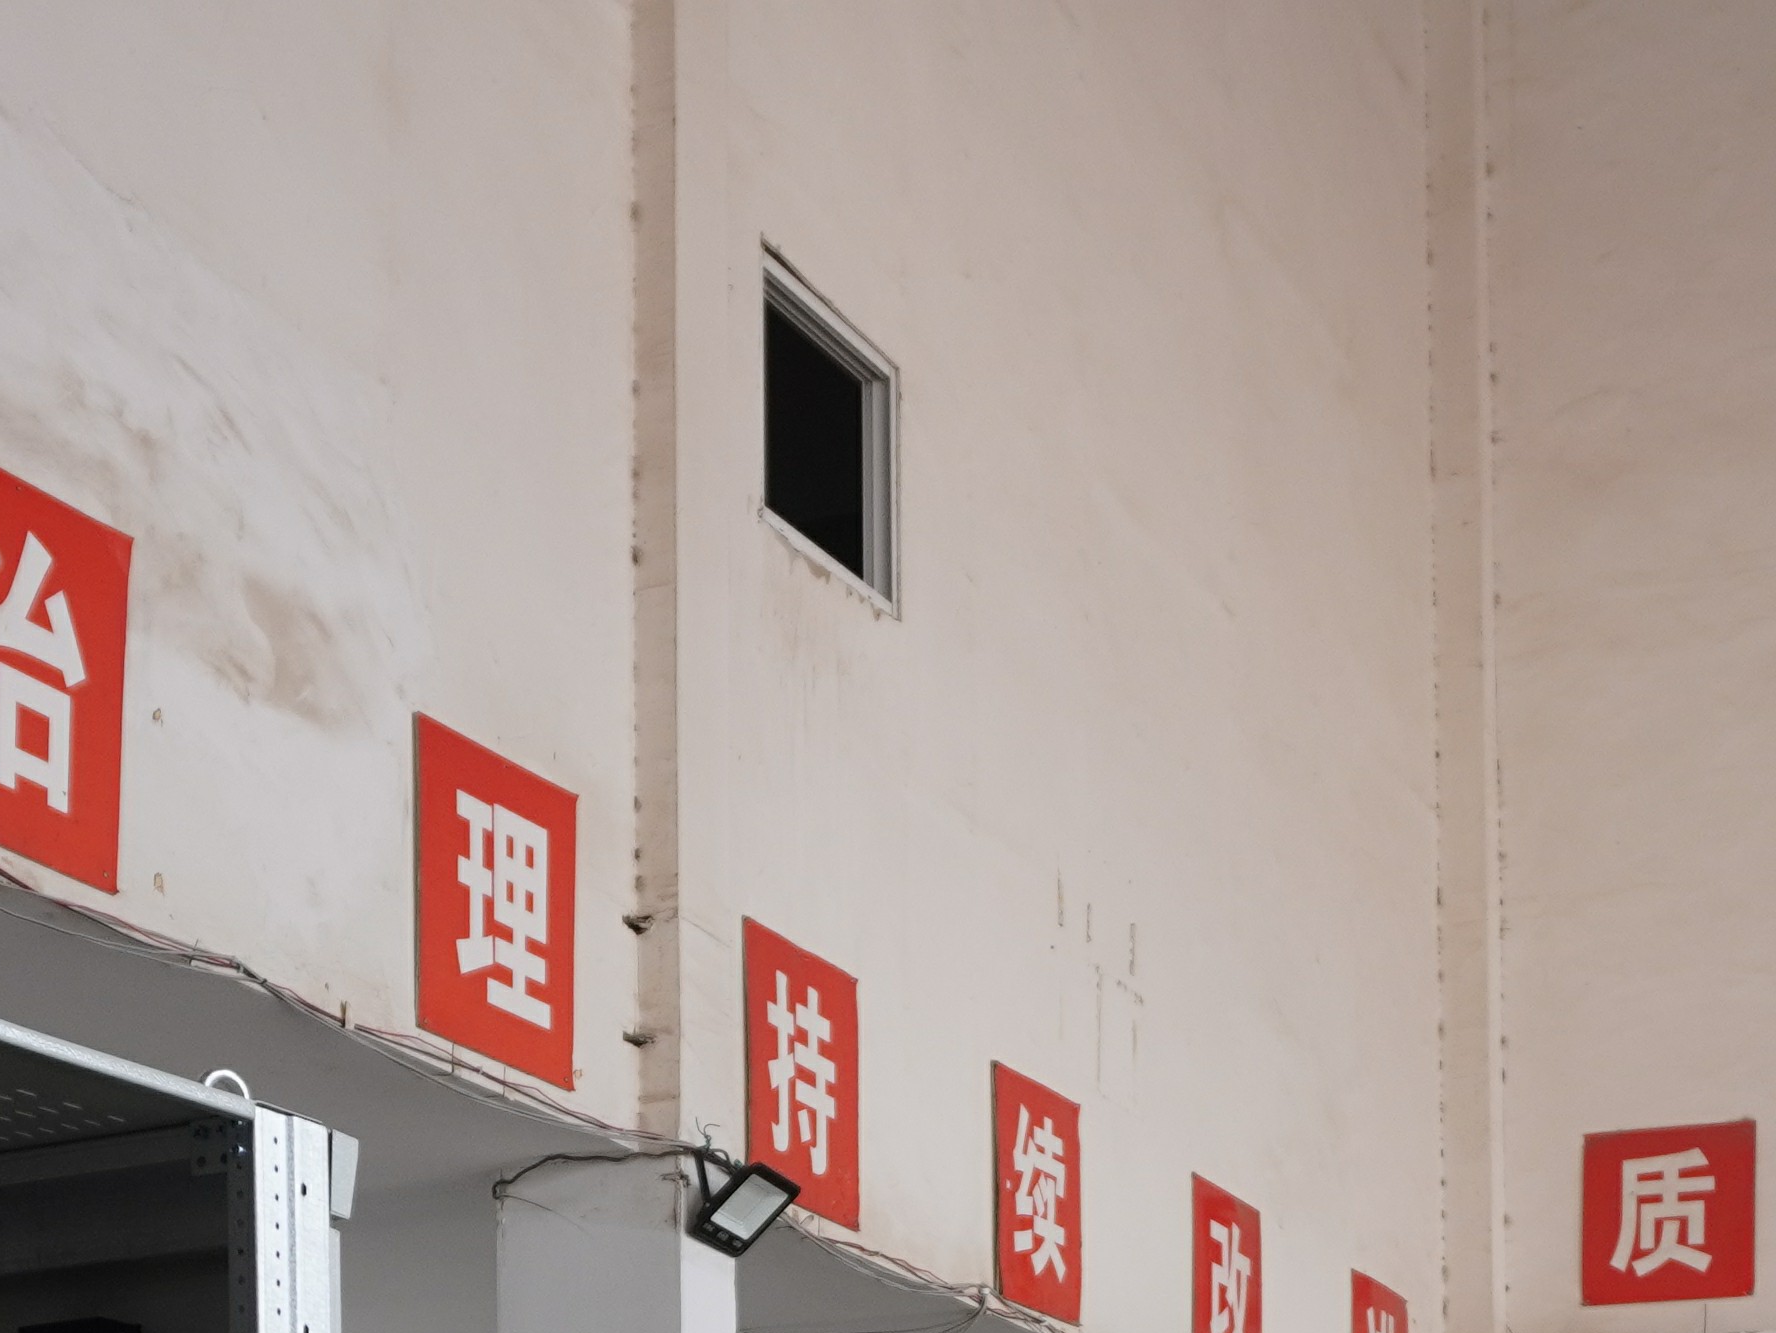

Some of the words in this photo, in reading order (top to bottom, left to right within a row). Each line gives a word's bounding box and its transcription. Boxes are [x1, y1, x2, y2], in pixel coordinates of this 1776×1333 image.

[455, 788, 552, 1030] 理
[767, 970, 836, 1176] 持
[1013, 1104, 1066, 1283] 续
[1610, 1147, 1715, 1277] 质
